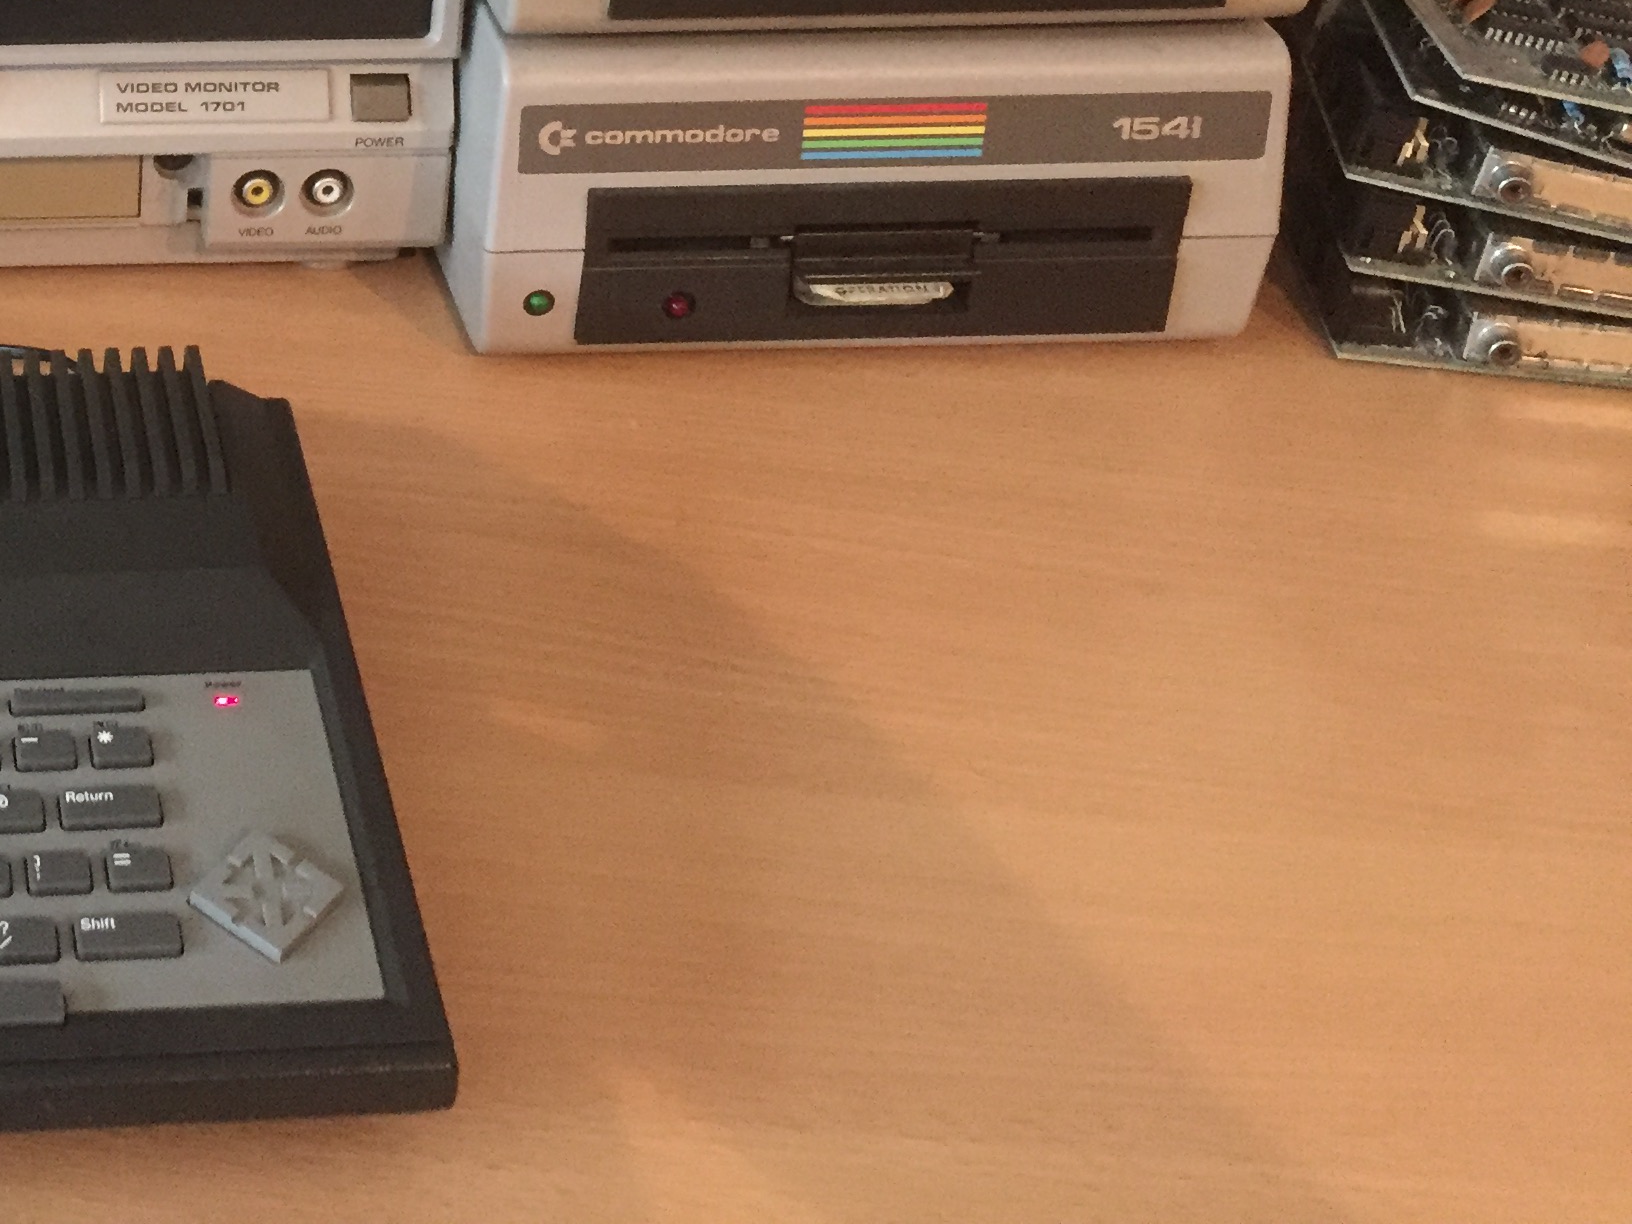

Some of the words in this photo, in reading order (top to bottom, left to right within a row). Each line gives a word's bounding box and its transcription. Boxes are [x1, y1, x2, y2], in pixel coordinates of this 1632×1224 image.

[115, 80, 179, 95] VIDEO
[183, 80, 281, 94] MONITOR
[115, 100, 189, 114] MODEL
[199, 100, 246, 113] 1701
[584, 124, 781, 145] commodore
[1112, 114, 1203, 141] 1541
[354, 136, 405, 148] POWER
[237, 226, 274, 238] VIDEO
[304, 224, 342, 236] AUDIO
[65, 790, 114, 804] Return
[79, 917, 117, 931] Shift
